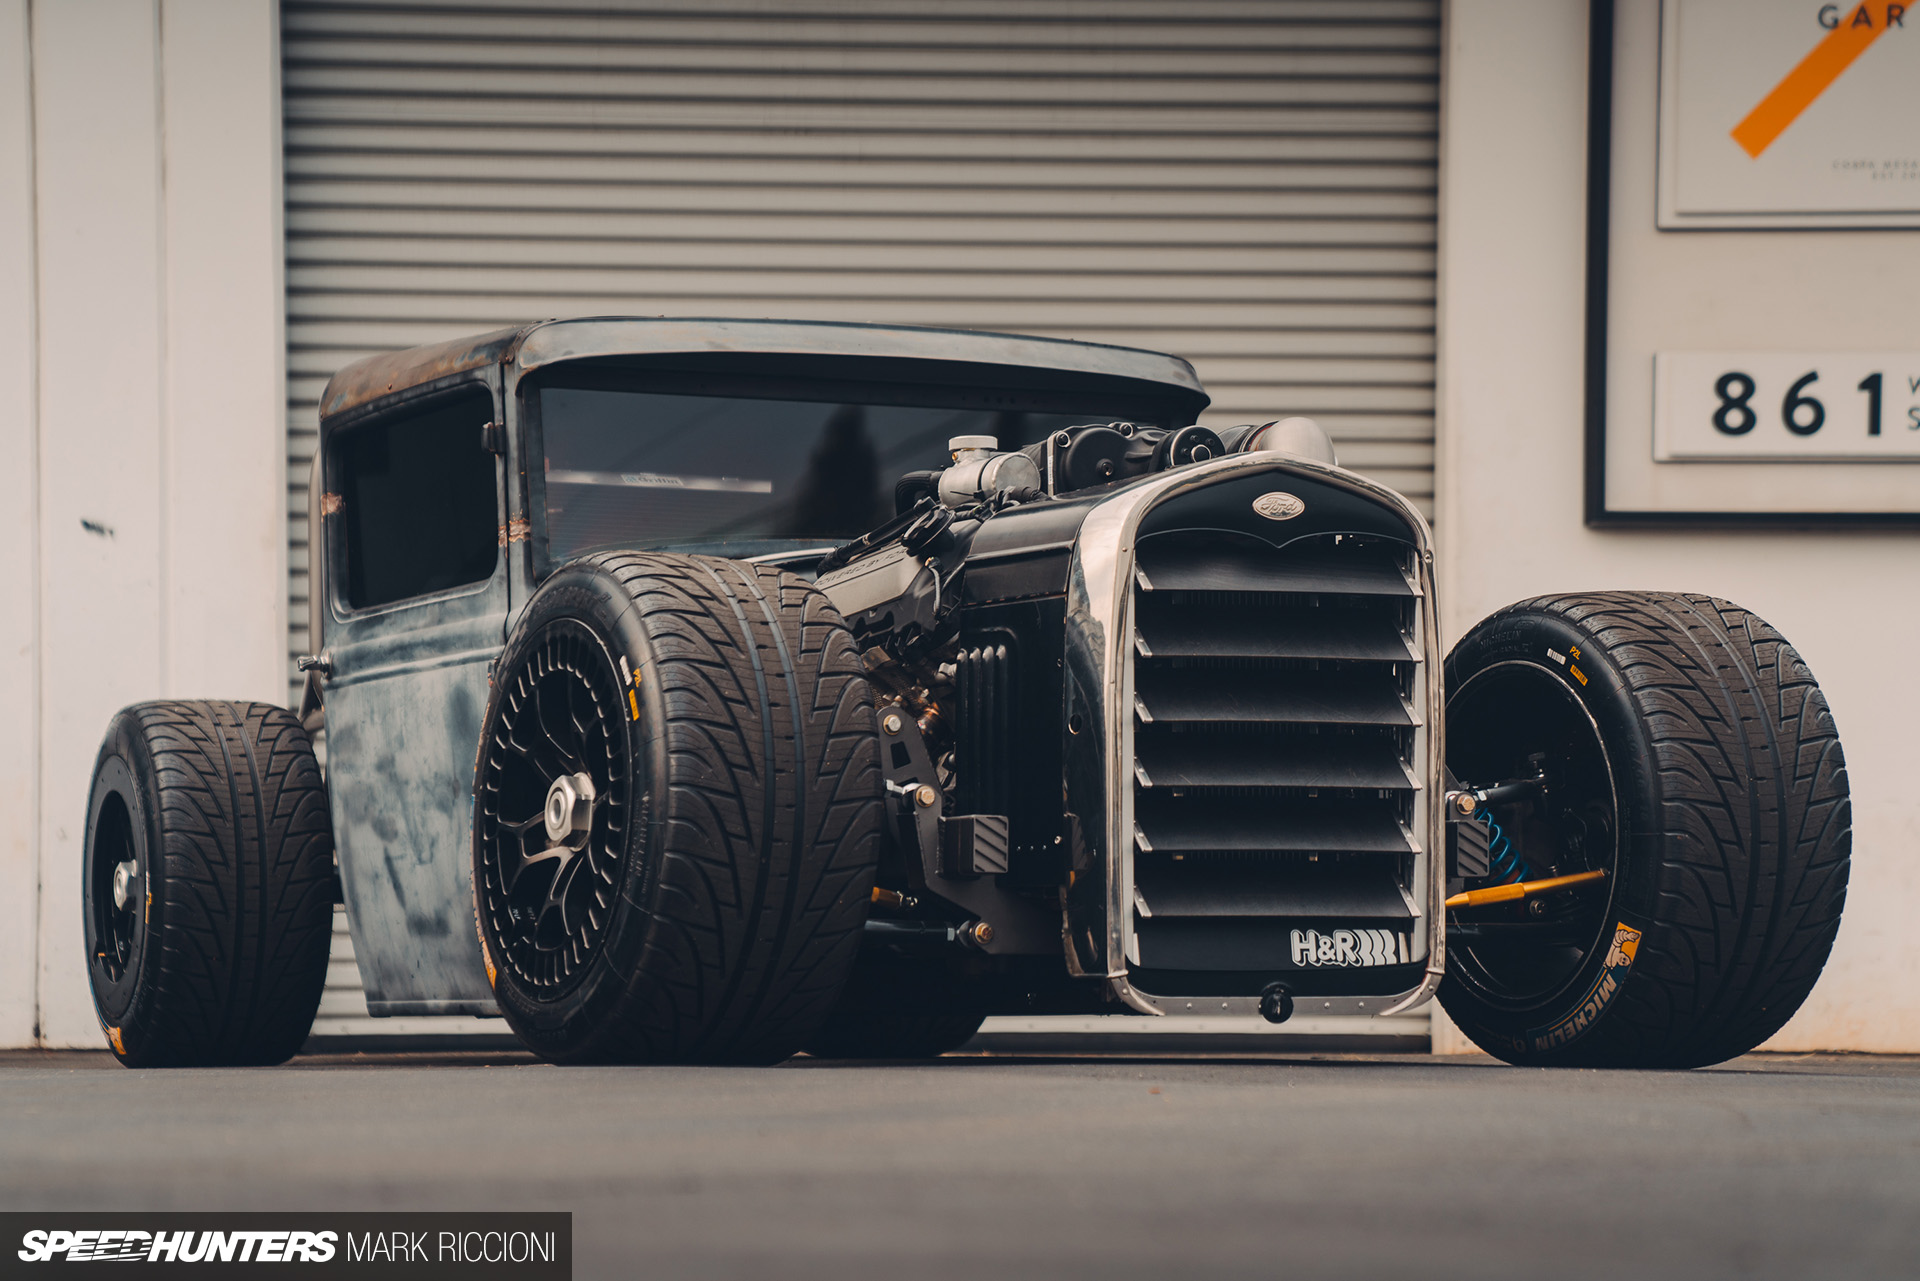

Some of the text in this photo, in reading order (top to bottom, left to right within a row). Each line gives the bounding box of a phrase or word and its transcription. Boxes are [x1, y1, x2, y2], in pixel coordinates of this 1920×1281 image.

[1817, 4, 1905, 29] GAR
[1711, 371, 1882, 437] 861
[1260, 496, 1298, 513] Ford
[1290, 929, 1362, 967] H&R
[1535, 973, 1618, 1051] MICHELIN
